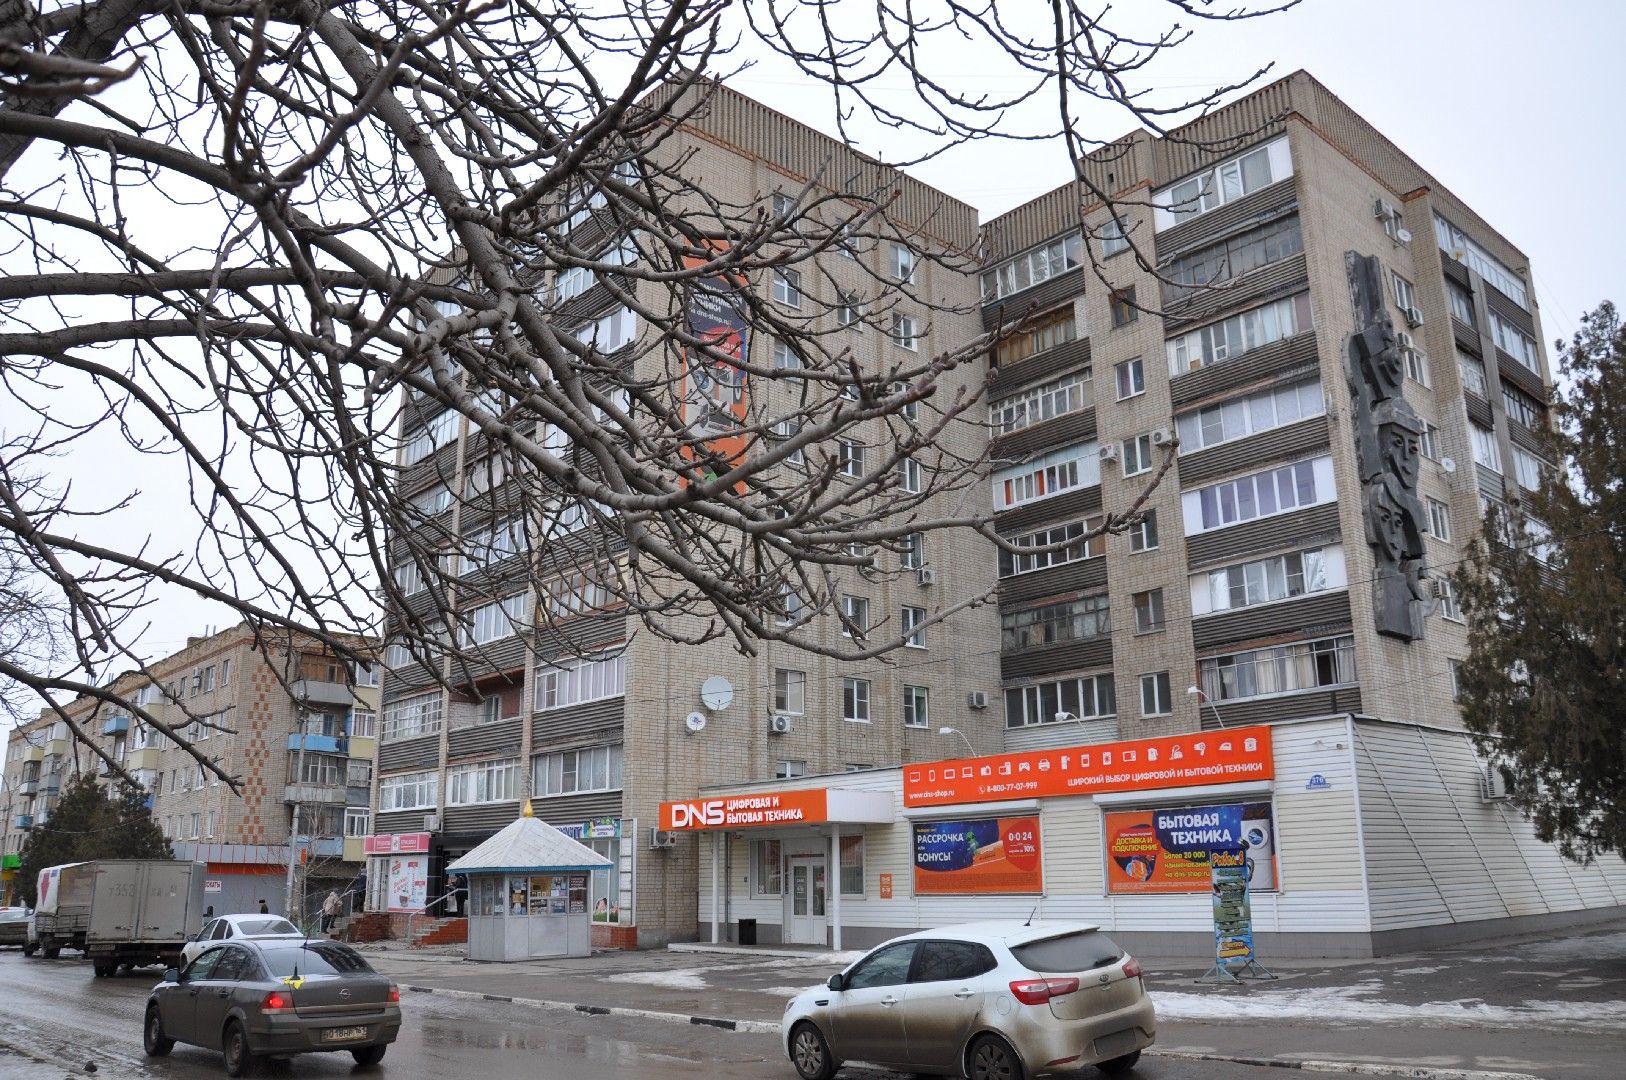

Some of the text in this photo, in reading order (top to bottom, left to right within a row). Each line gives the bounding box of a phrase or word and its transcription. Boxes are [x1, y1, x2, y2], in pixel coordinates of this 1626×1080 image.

[1067, 761, 1263, 787] ШИРОКИЙ ВЫБОР ЦИФРОВОЙ И БЫТОВОЙ ТЕХНИКИ
[986, 781, 1038, 793] 8-800-77-07-999
[908, 789, 955, 800] www.dns-shop.ru
[726, 796, 779, 810] ЦИФРОВАЯ И
[671, 800, 724, 828] DNS
[726, 808, 803, 824] БЫТОВАЯ ТЕХНИКА
[1158, 812, 1220, 830] БЫТОВАЯ
[917, 832, 964, 844] РАССРОЧКА
[1115, 837, 1147, 846] ДОСТАВКА
[1171, 828, 1233, 846] ТЕХНИКА
[917, 851, 951, 863] БОНУСЫ
[1184, 851, 1192, 859] 20
[1192, 851, 1206, 859] 000
